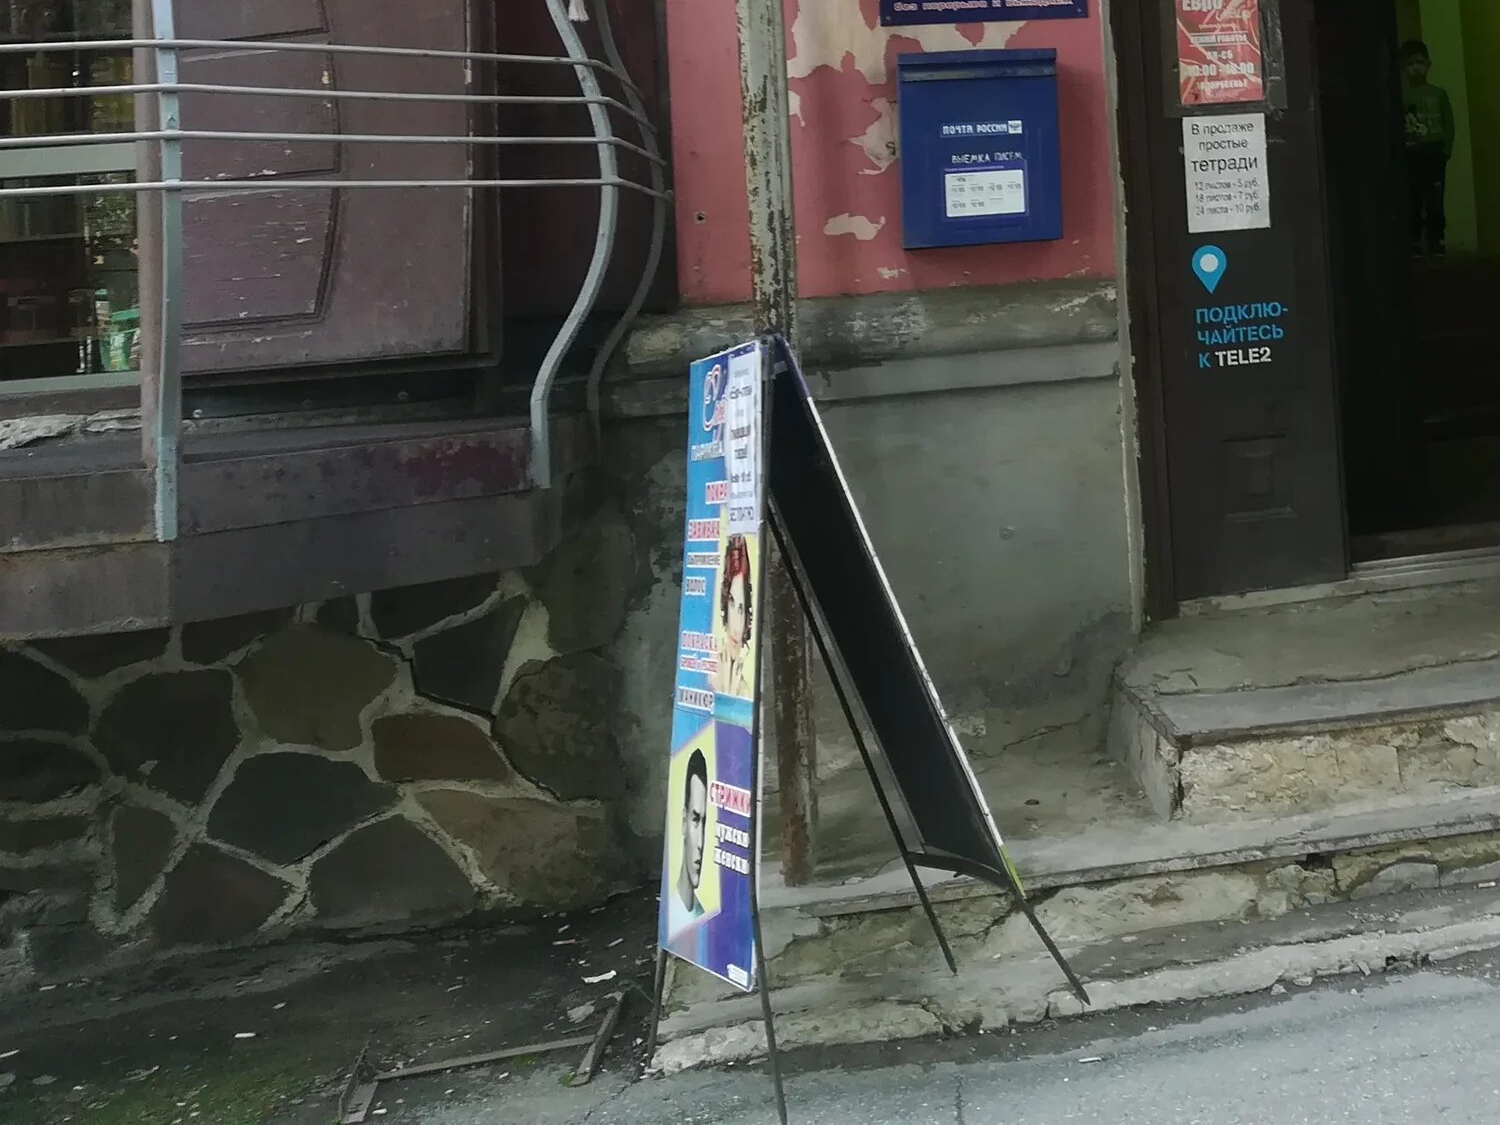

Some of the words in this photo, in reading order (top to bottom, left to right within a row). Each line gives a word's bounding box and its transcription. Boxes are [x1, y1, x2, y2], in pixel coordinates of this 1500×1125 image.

[943, 125, 973, 135] ПОЧТА
[977, 123, 1008, 133] РОССИИ
[1191, 124, 1200, 135] В
[1203, 123, 1254, 136] продаже
[1198, 138, 1248, 152] простые
[1191, 156, 1259, 174] тетради
[1196, 301, 1288, 325] ПОДКЛЮ-
[1197, 324, 1284, 346] ЧАЙТЕСЬ
[1199, 352, 1211, 368] К
[1215, 347, 1272, 367] TELE2
